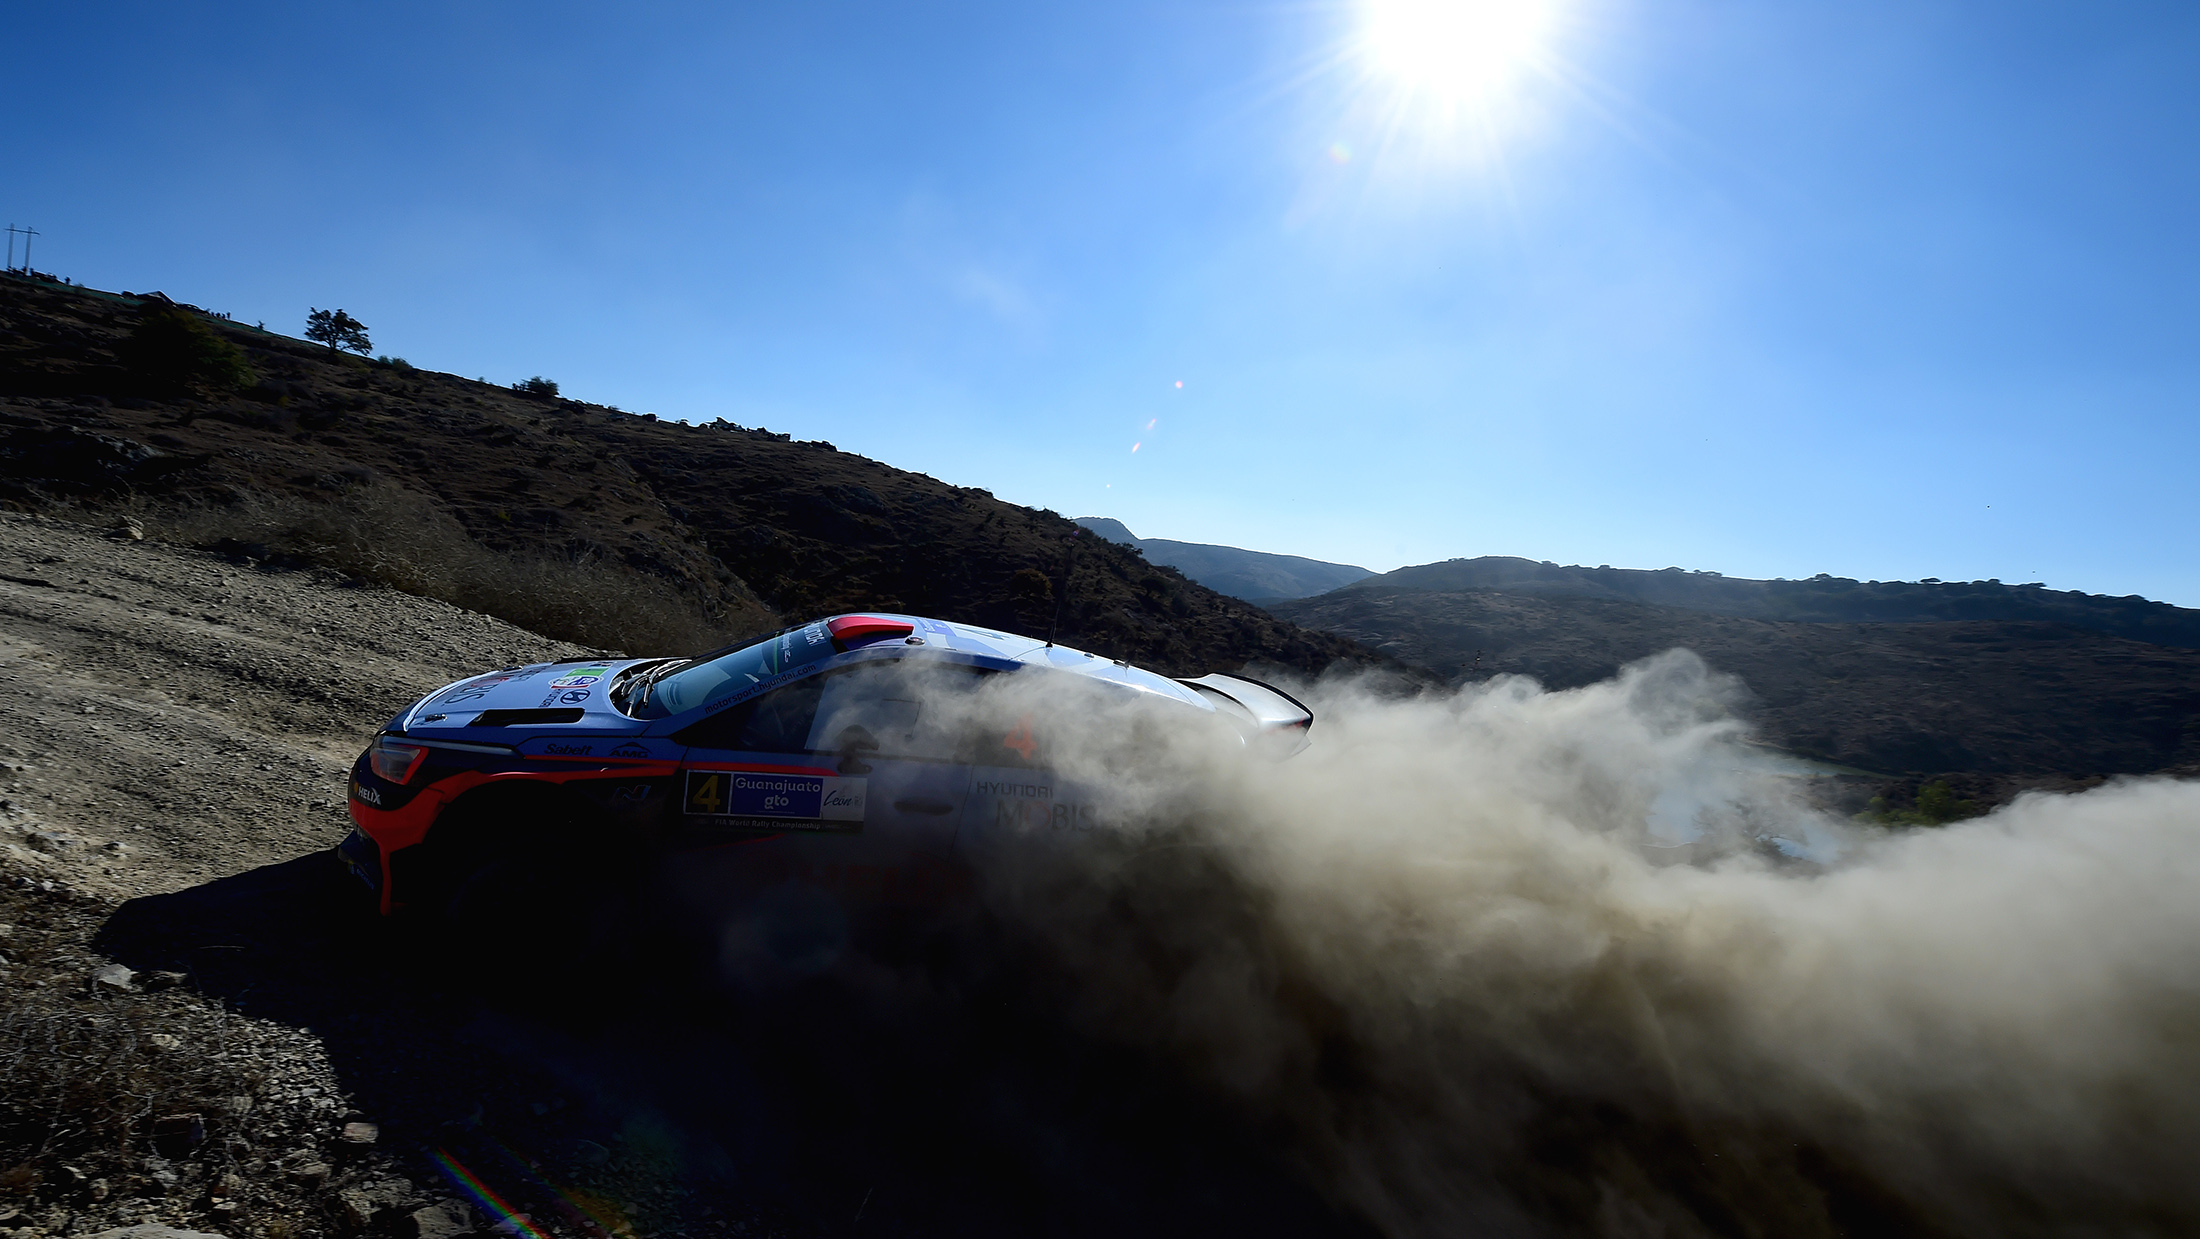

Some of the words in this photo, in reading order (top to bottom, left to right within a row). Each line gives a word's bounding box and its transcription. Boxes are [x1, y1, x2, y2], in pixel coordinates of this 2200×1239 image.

[704, 664, 817, 714] motorsport.hyundai.com
[1003, 711, 1038, 761] 4
[544, 743, 594, 756] Sabelt
[691, 774, 721, 813] 4
[735, 777, 821, 794] Guanajuato
[976, 781, 1054, 799] HYUNDAI
[357, 785, 382, 806] HELIX
[763, 794, 790, 810] gto
[714, 818, 727, 826] FIA
[728, 818, 750, 827] World
[751, 819, 770, 830] Rally
[771, 820, 822, 831] Championship
[995, 799, 1097, 832] MOBIS
